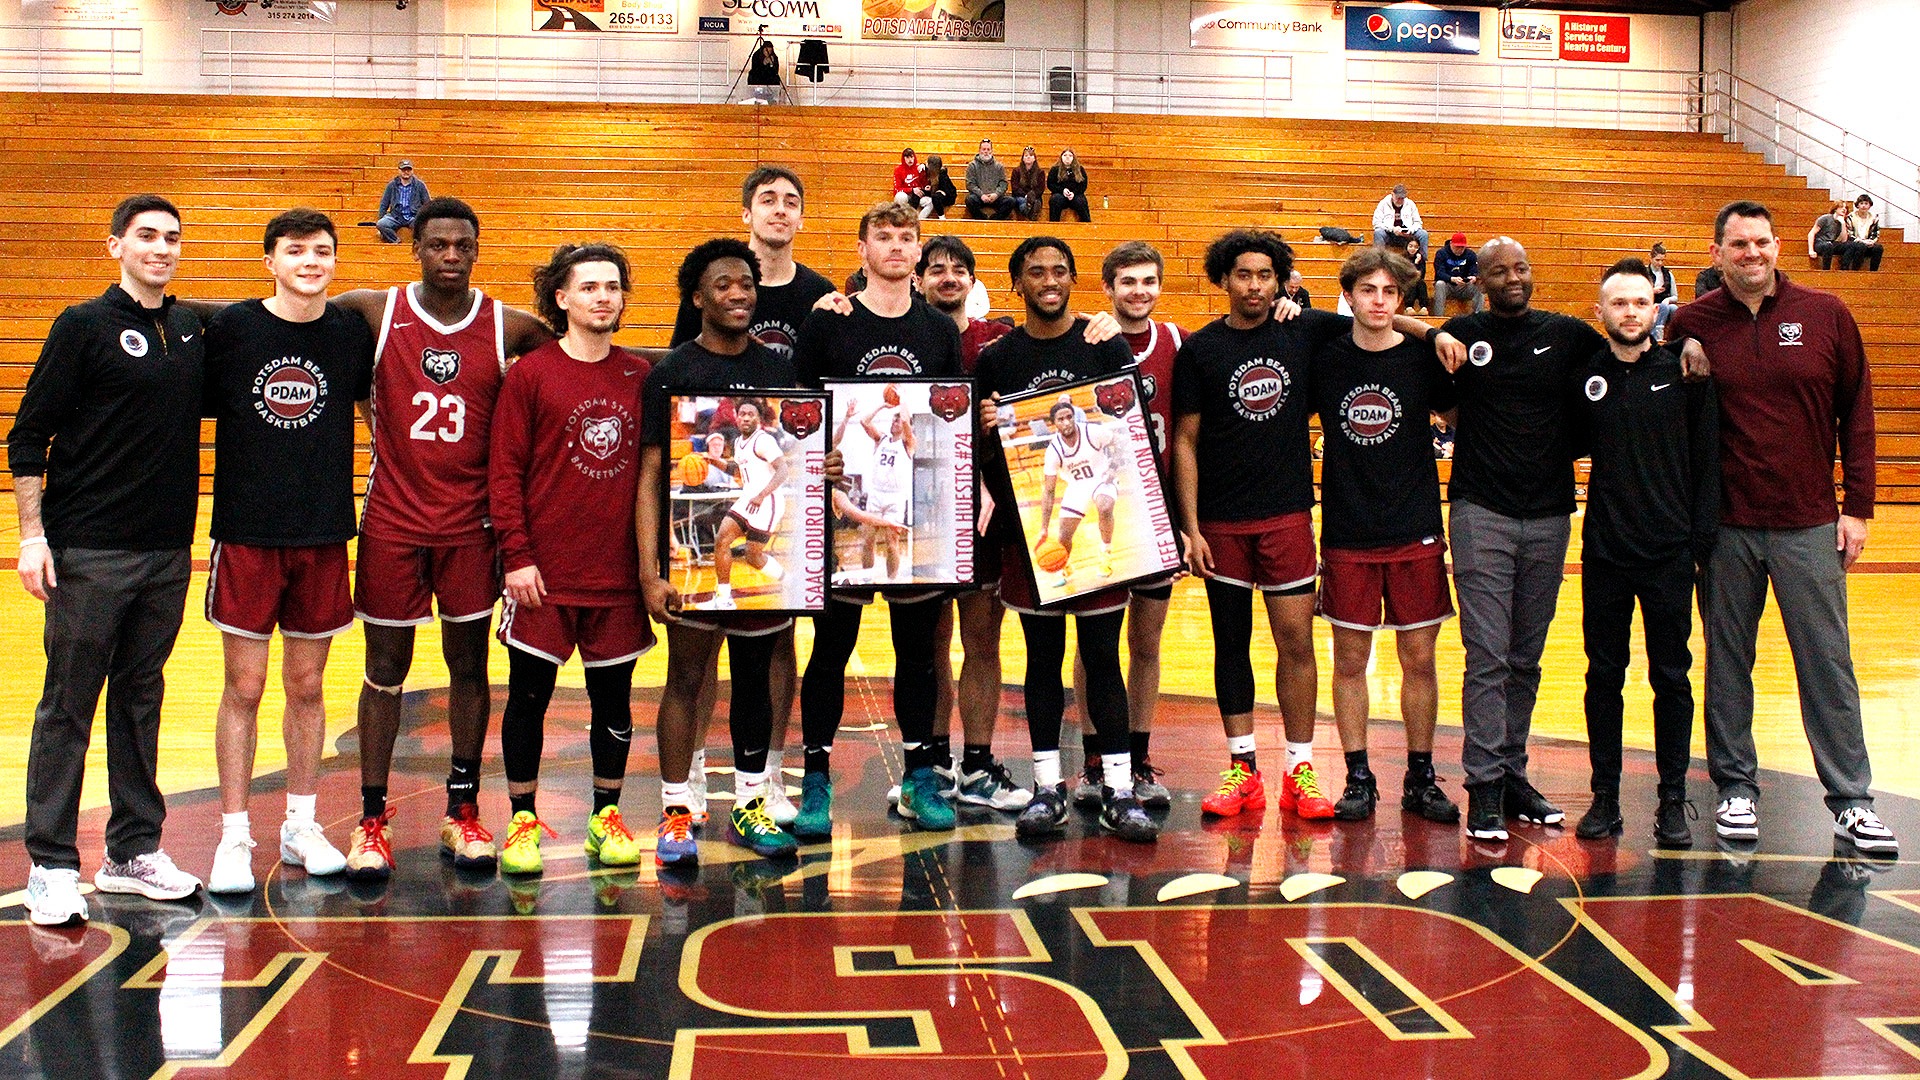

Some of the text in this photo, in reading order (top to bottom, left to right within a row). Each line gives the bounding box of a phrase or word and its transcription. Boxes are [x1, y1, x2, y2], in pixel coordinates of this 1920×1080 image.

[298, 12, 314, 20] 2014
[609, 12, 673, 24] 265-0133
[1218, 19, 1322, 33] Community Bank
[1564, 22, 1607, 32] A History of
[863, 18, 1004, 38] POTSDAMBEARS.COM
[1396, 21, 1460, 44] pepsi
[1503, 24, 1551, 40] CSEA
[1564, 32, 1606, 42] Service for
[1564, 42, 1590, 52] Nearly
[1596, 44, 1626, 54] Century
[748, 320, 780, 335] SDAM
[856, 345, 922, 374] OTSDAM BEAR
[252, 356, 328, 396] POTSDAM BEARS
[1028, 370, 1058, 388] SDAM
[1228, 358, 1292, 398] POTSDAM BEARS
[271, 386, 311, 400] PDAM
[1244, 382, 1278, 398] PDAM
[1340, 384, 1402, 418] POTSDAM BEARS
[254, 401, 326, 430] BASKETBALL
[410, 392, 466, 442] 23
[565, 398, 635, 432] POTSDAM STATE
[1233, 390, 1290, 422] BASKETBALL
[1353, 410, 1387, 420] PDAM
[1150, 412, 1166, 454] 3
[1340, 422, 1400, 446] BASKETBALL
[570, 456, 628, 479] BASKETBALL
[880, 454, 896, 467] 24
[1071, 465, 1094, 480] 20
[1127, 414, 1181, 568] JEFF WILLIAMSON #20
[955, 432, 974, 584] COLTON HUESTIS #24
[805, 450, 825, 610] ISAAC ODURO JR. #11
[0, 893, 1920, 1080] TSDA
